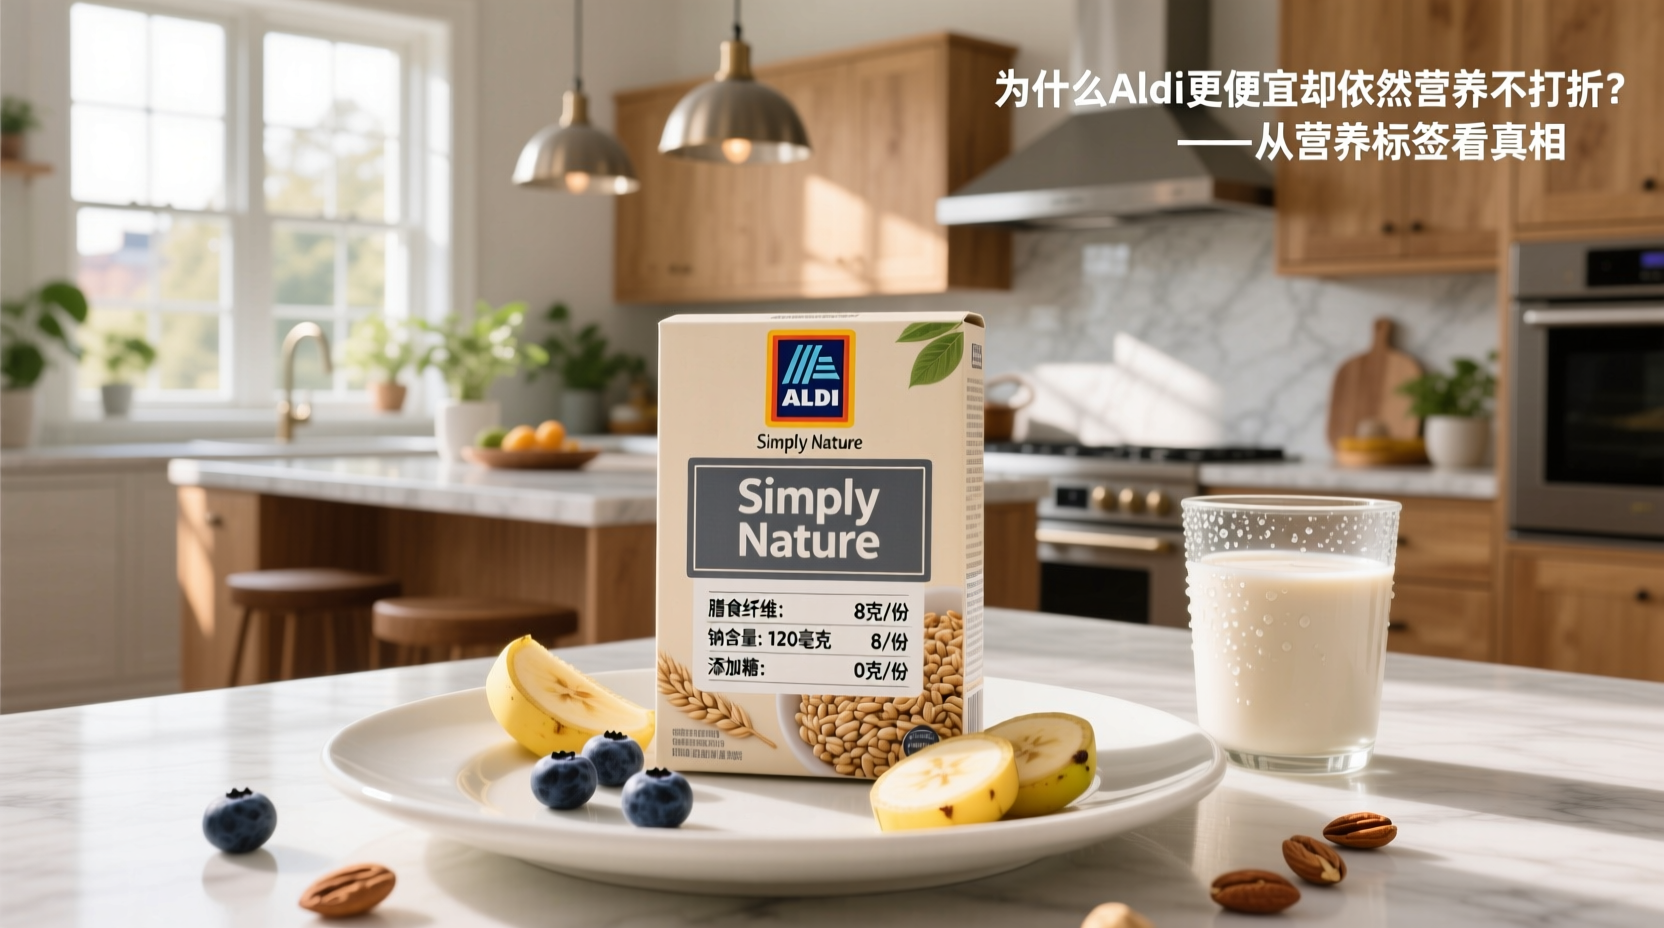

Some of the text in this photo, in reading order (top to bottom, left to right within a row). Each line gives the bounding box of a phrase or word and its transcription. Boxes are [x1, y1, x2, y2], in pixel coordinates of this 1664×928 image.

[781, 389, 839, 407] ALDI
[756, 433, 863, 454] Simply Nature
[738, 477, 880, 526] Simply
[738, 522, 880, 559] Nature
[854, 602, 909, 622] 8克/份
[871, 632, 909, 652] 8/份
[854, 661, 909, 681] 0克/份
